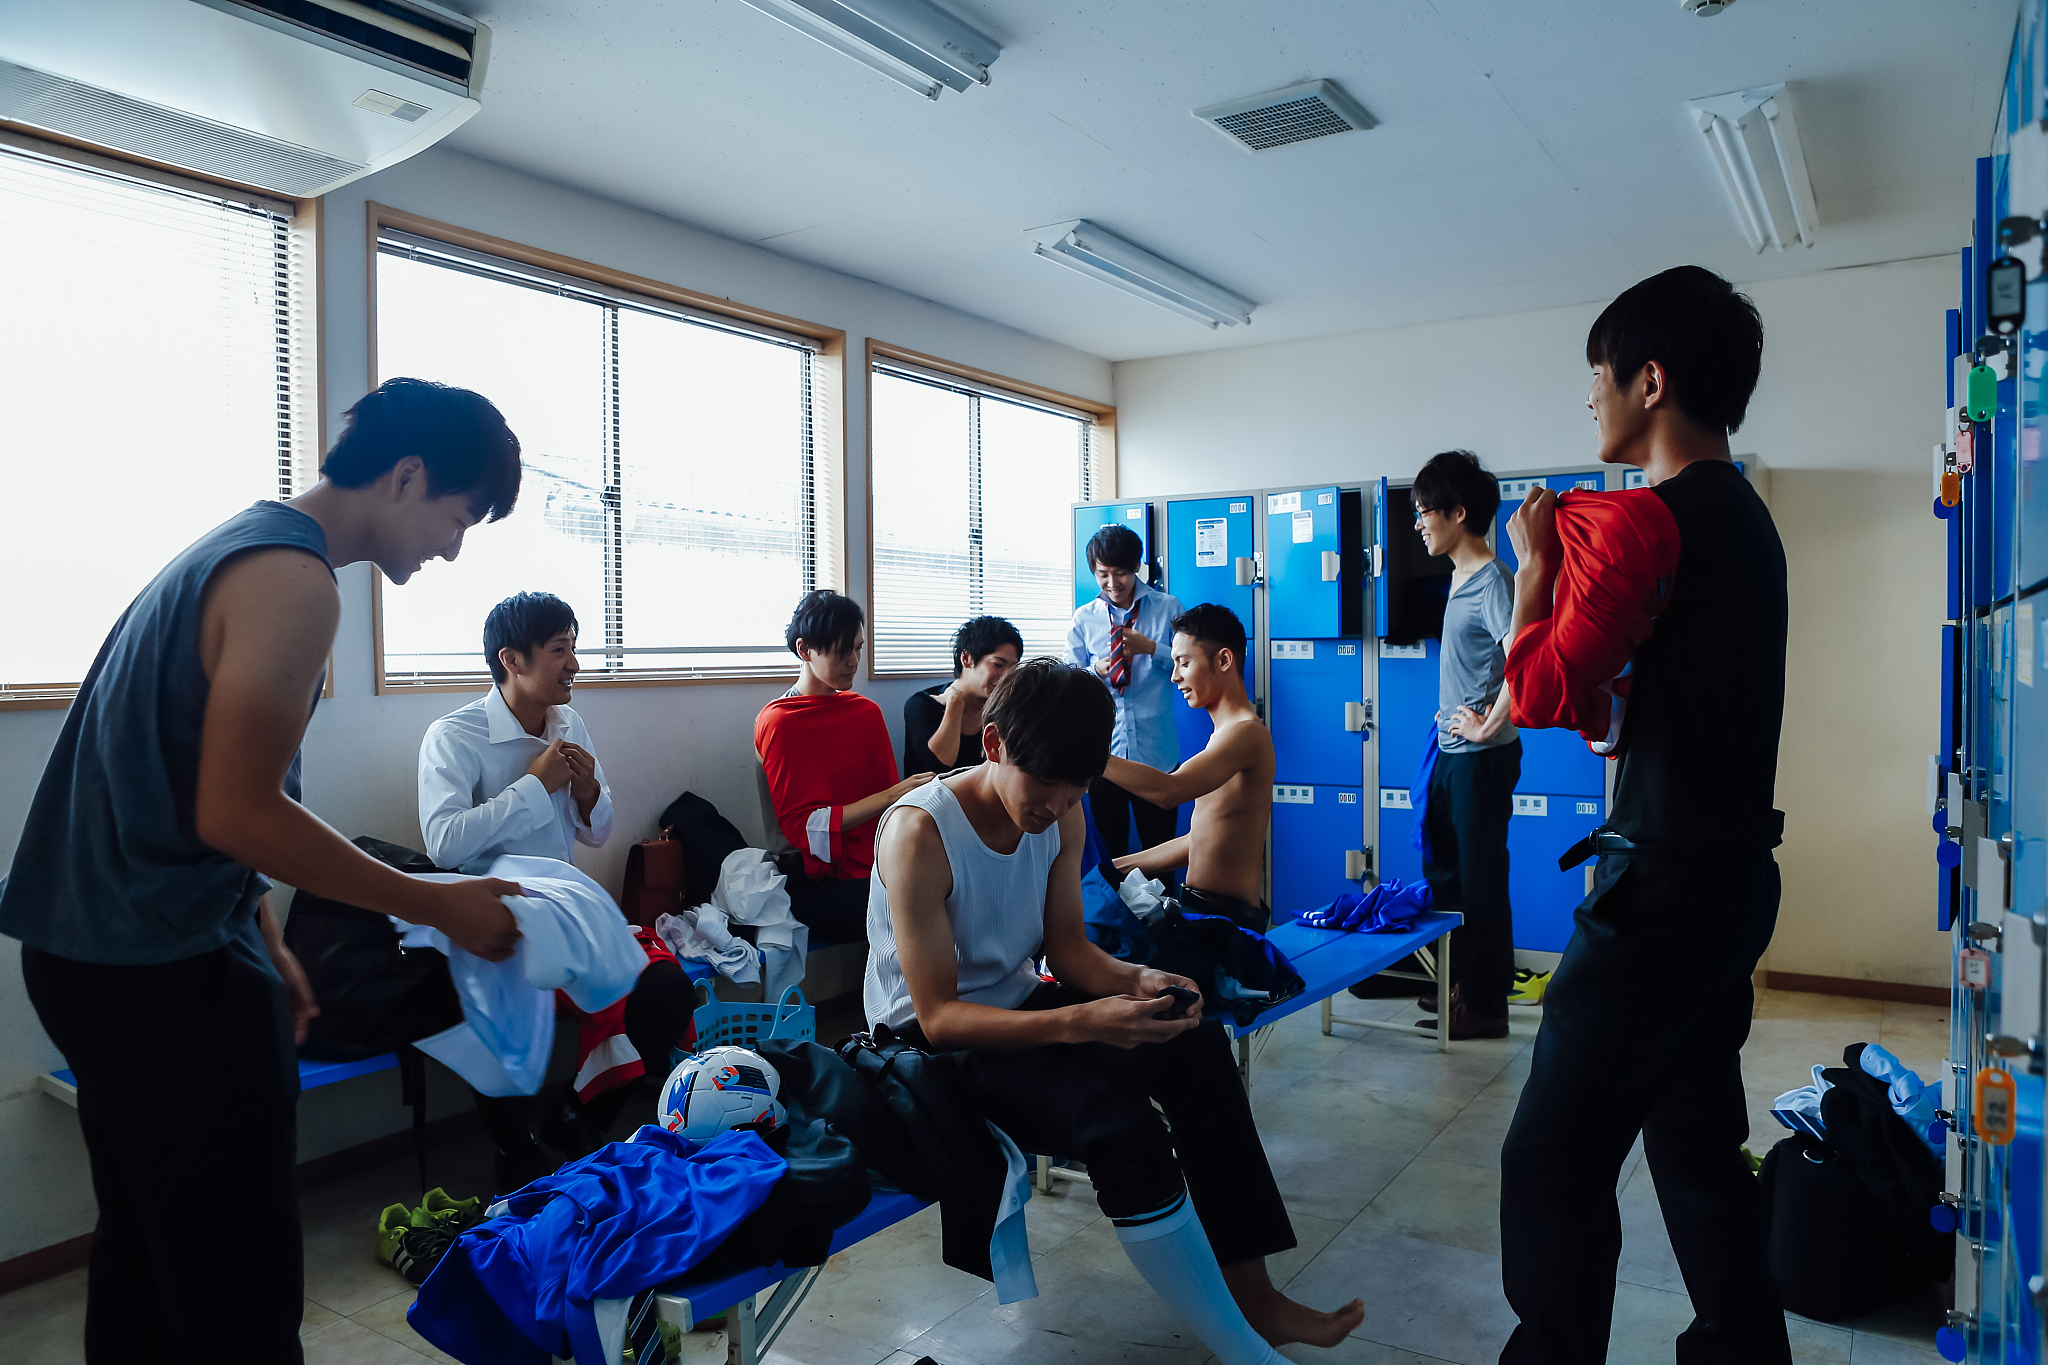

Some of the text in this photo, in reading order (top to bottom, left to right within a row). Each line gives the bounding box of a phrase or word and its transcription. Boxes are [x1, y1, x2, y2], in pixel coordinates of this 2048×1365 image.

[1231, 504, 1245, 513] 0004
[1338, 645, 1355, 655] 0008
[1339, 794, 1356, 803] 0009
[1577, 803, 1596, 813] 0015
